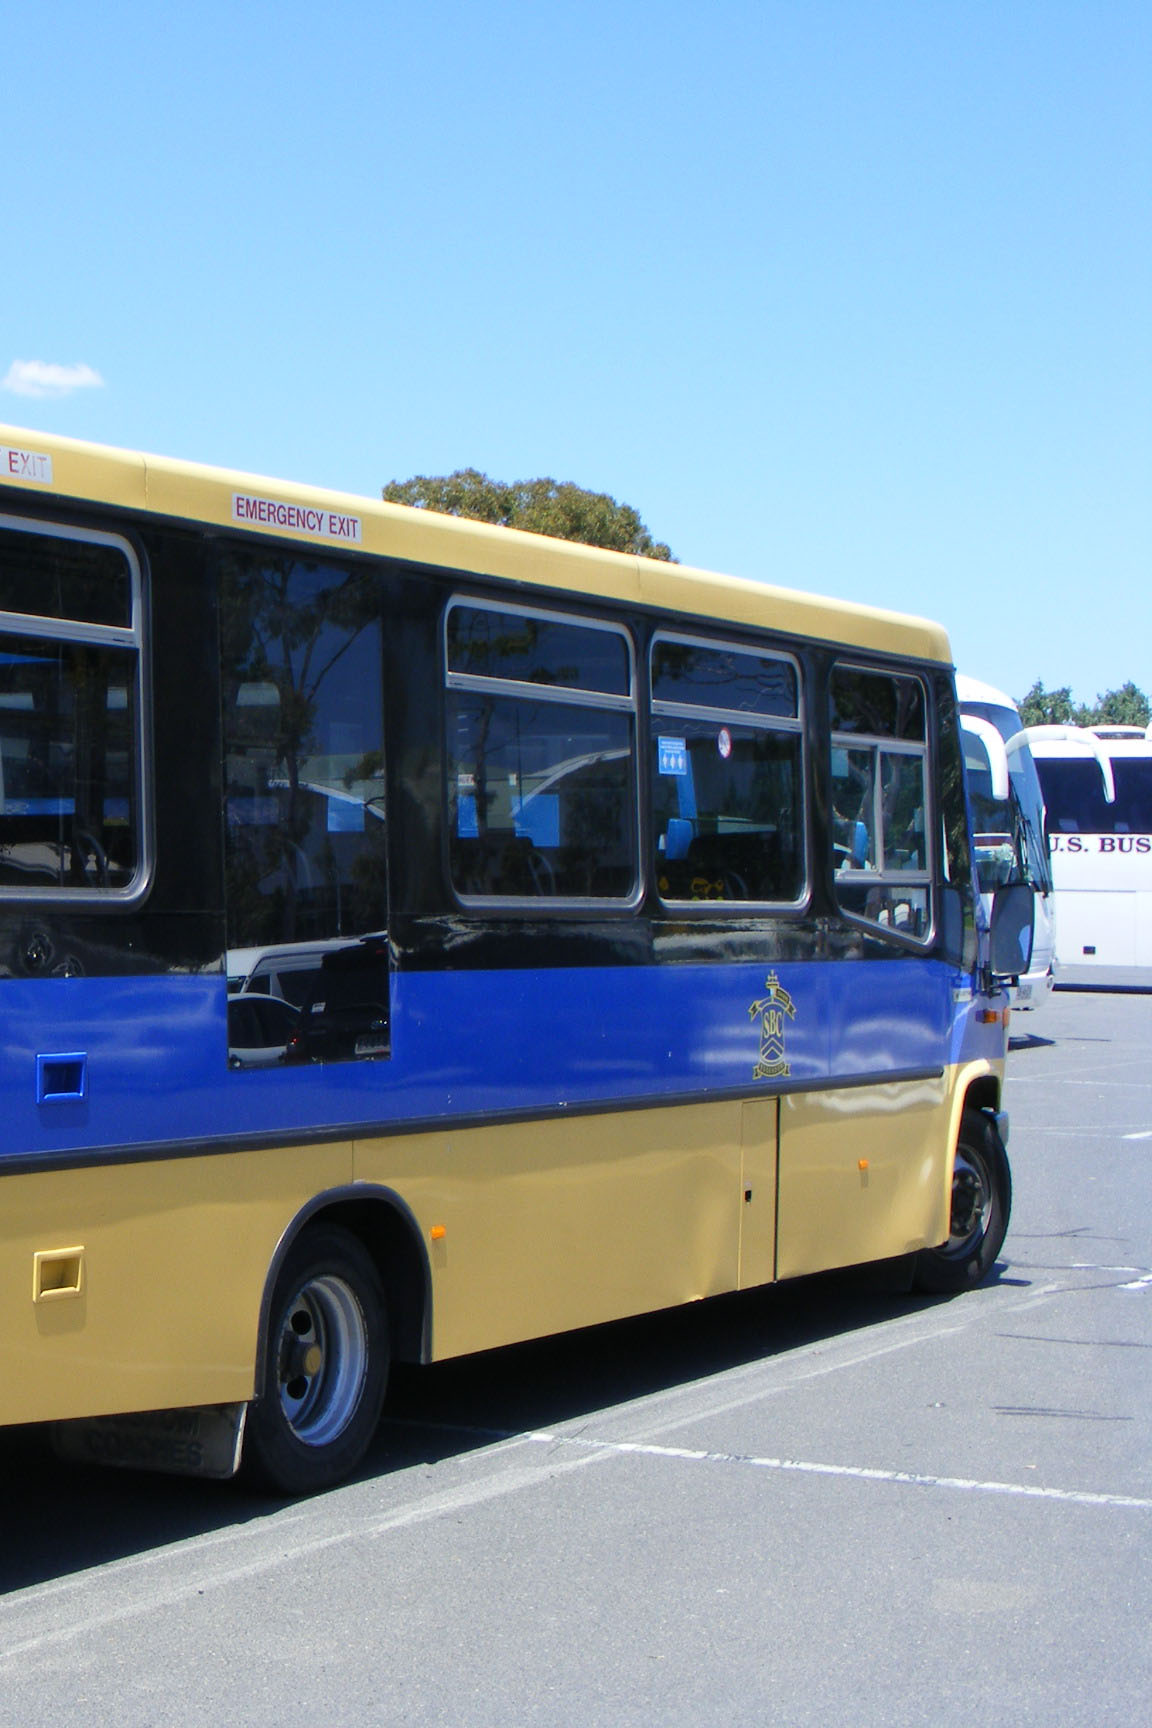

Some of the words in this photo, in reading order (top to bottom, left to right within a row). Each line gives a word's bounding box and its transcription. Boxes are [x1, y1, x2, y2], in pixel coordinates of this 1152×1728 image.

[8, 451, 48, 479] EXIT
[236, 496, 324, 532] EMERGENCY
[328, 515, 358, 538] EXIT
[1098, 836, 1152, 854] BUS
[763, 1009, 783, 1039] SBC
